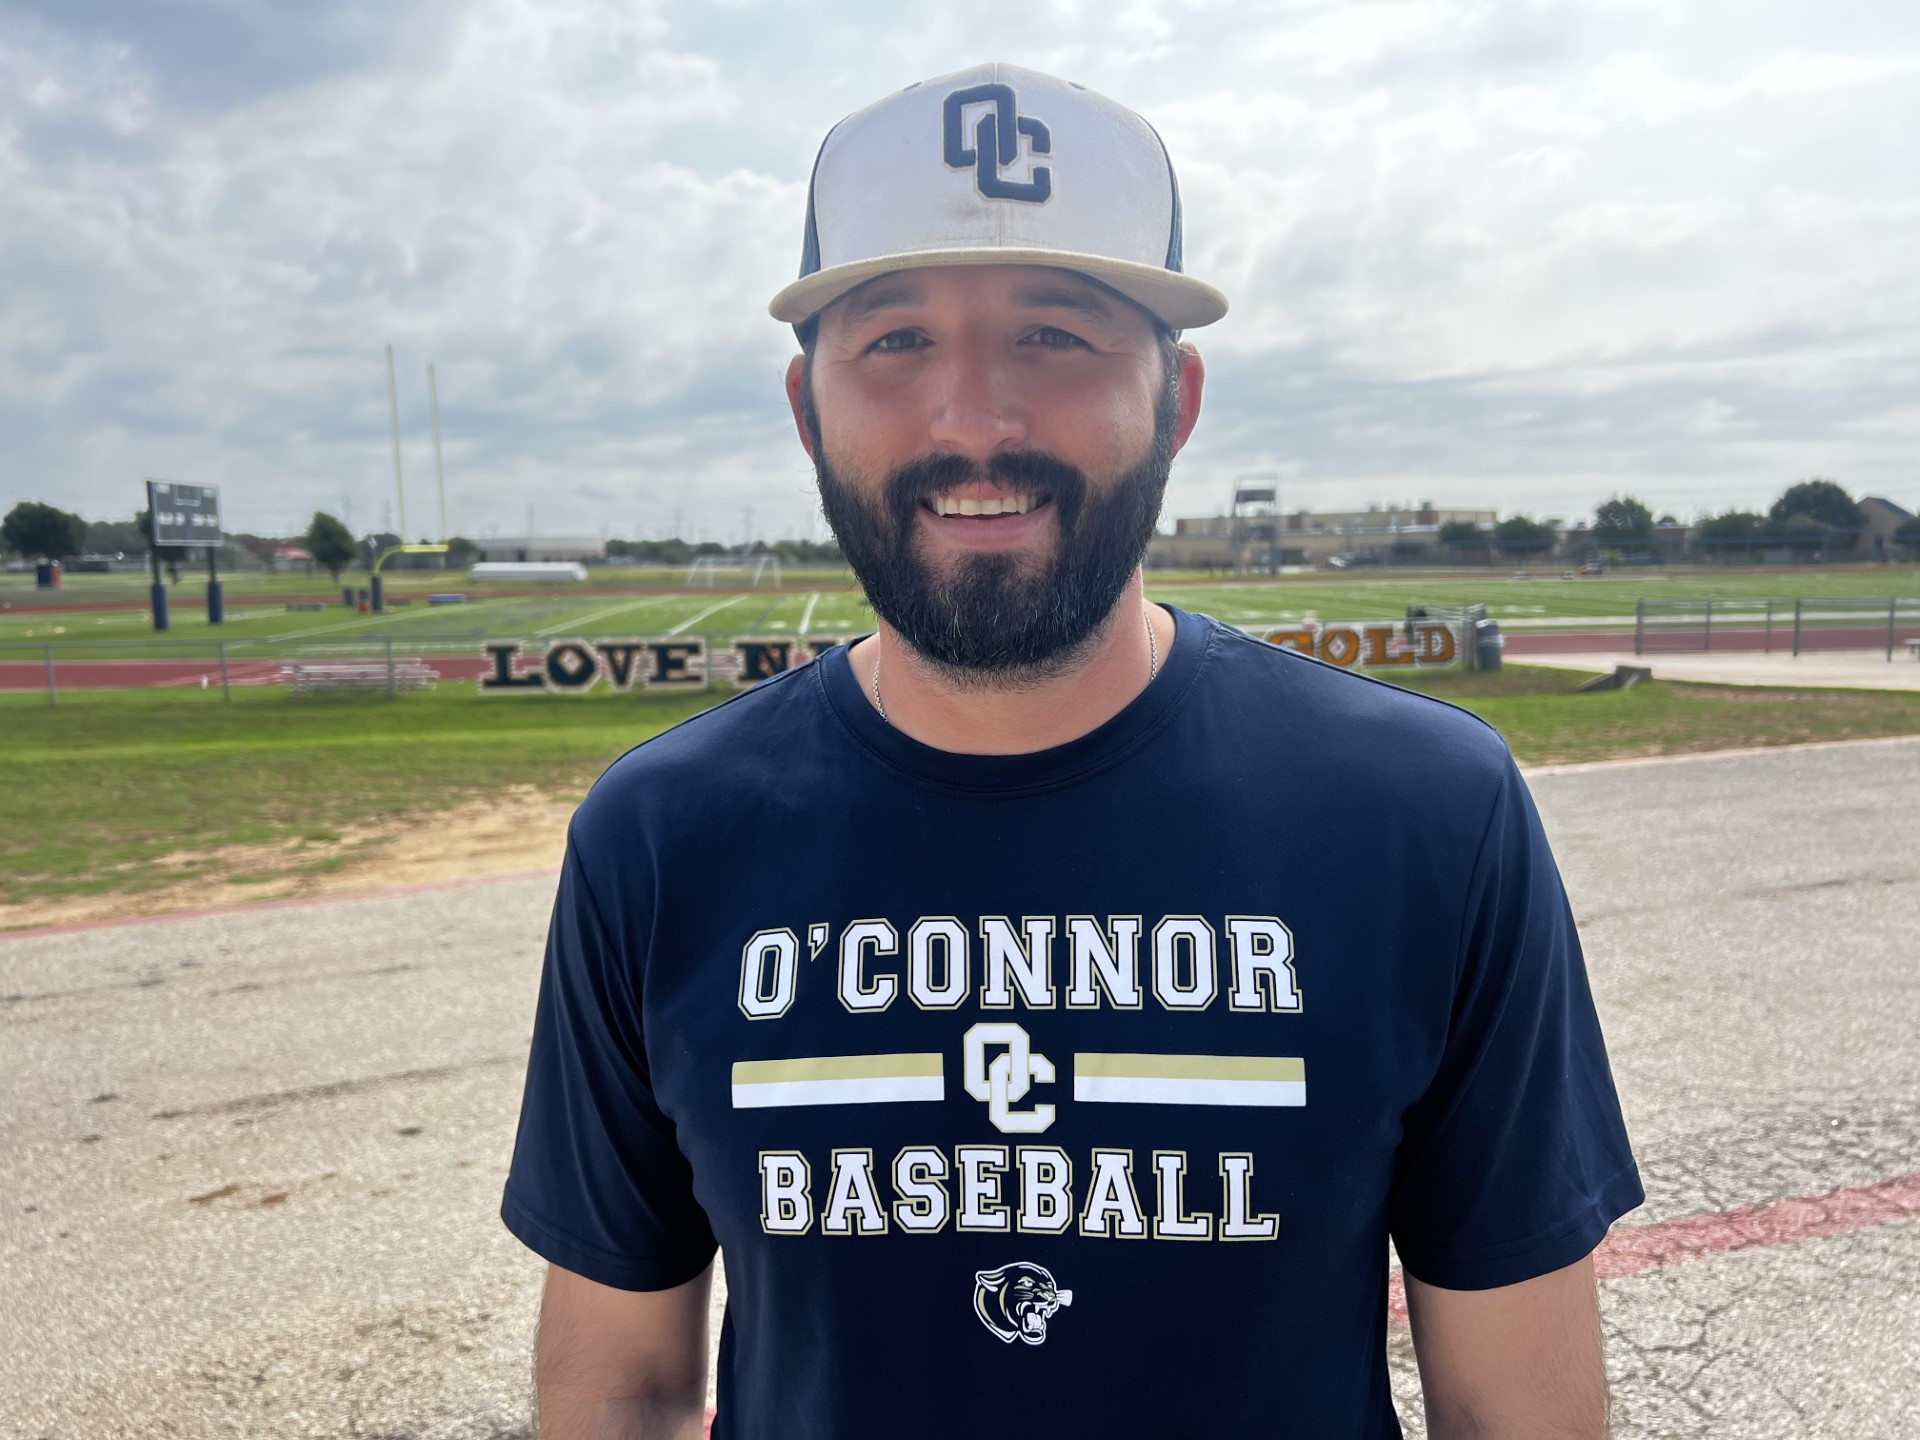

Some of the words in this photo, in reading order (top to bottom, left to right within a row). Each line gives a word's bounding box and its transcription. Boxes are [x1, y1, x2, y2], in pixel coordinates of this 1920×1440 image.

[942, 82, 1053, 204] OC
[481, 640, 704, 691] LOVE
[738, 915, 1303, 1020] O'CONNOR
[963, 1022, 1056, 1133] OC
[759, 1145, 1280, 1241] BASEBALL
